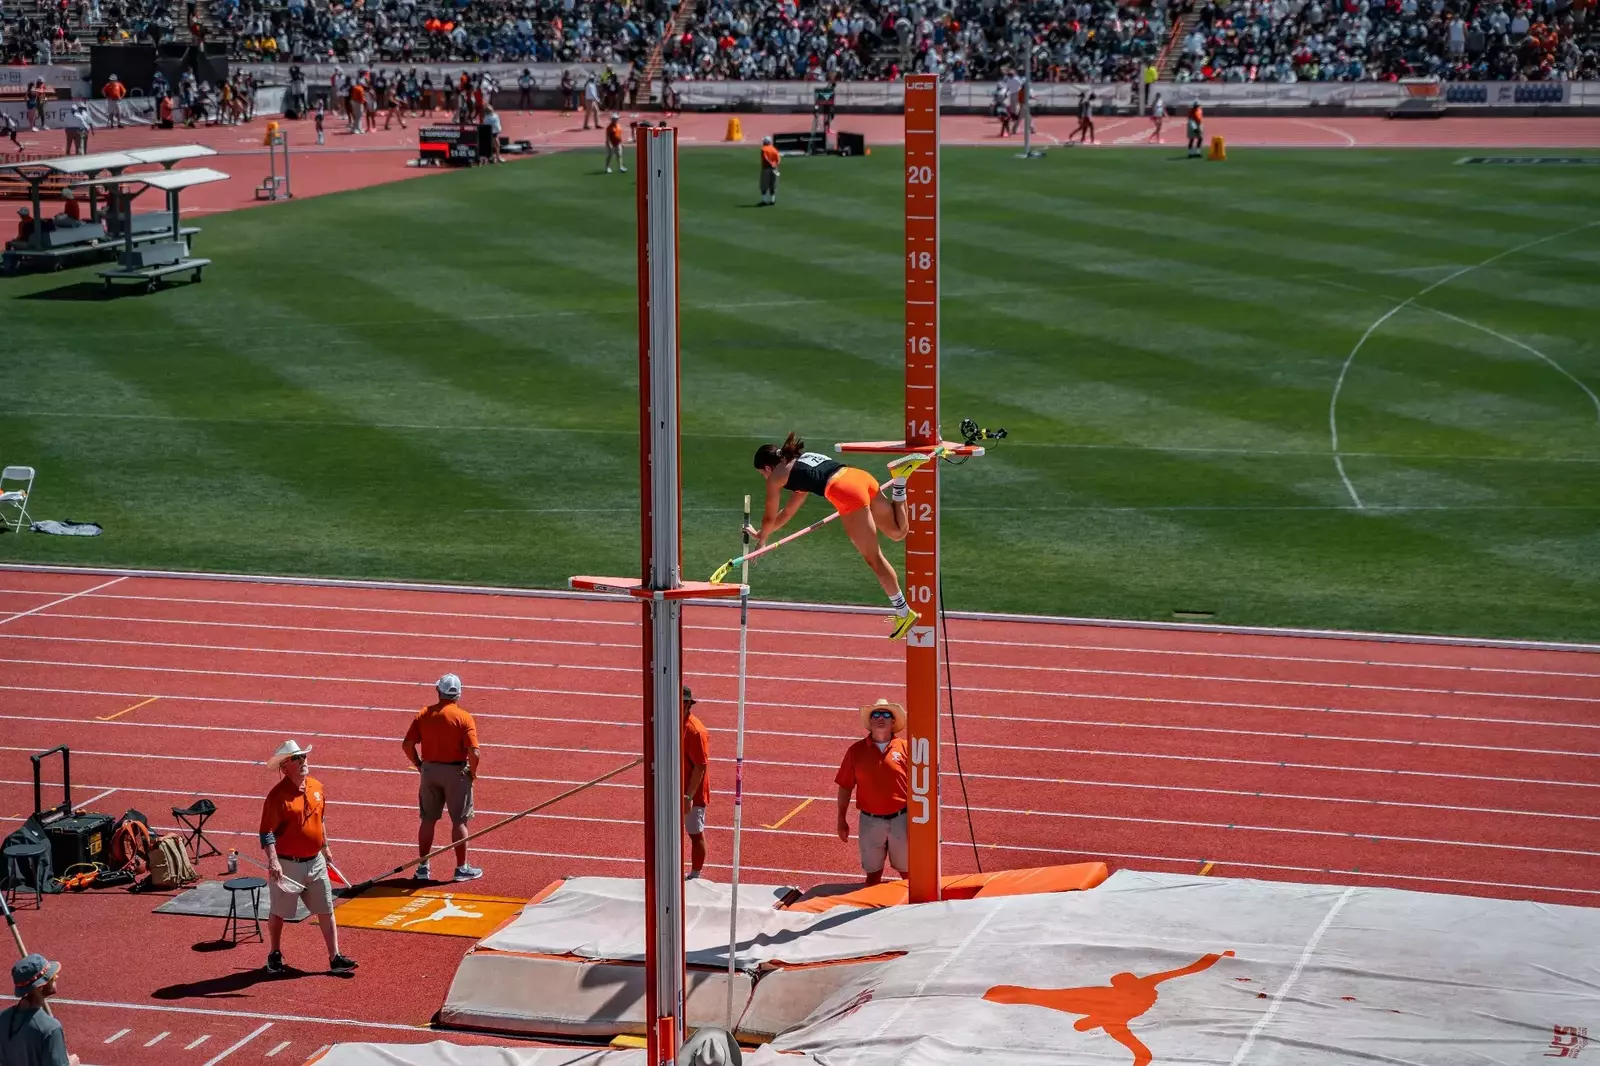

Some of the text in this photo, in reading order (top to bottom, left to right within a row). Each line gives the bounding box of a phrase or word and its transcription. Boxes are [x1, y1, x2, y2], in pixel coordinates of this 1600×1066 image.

[906, 82, 934, 90] UCS
[908, 165, 932, 184] 20
[908, 251, 931, 270] 18
[908, 336, 931, 354] 16
[908, 420, 931, 438] 14
[908, 503, 932, 522] 12
[908, 585, 931, 603] 10
[911, 737, 930, 824] UCS
